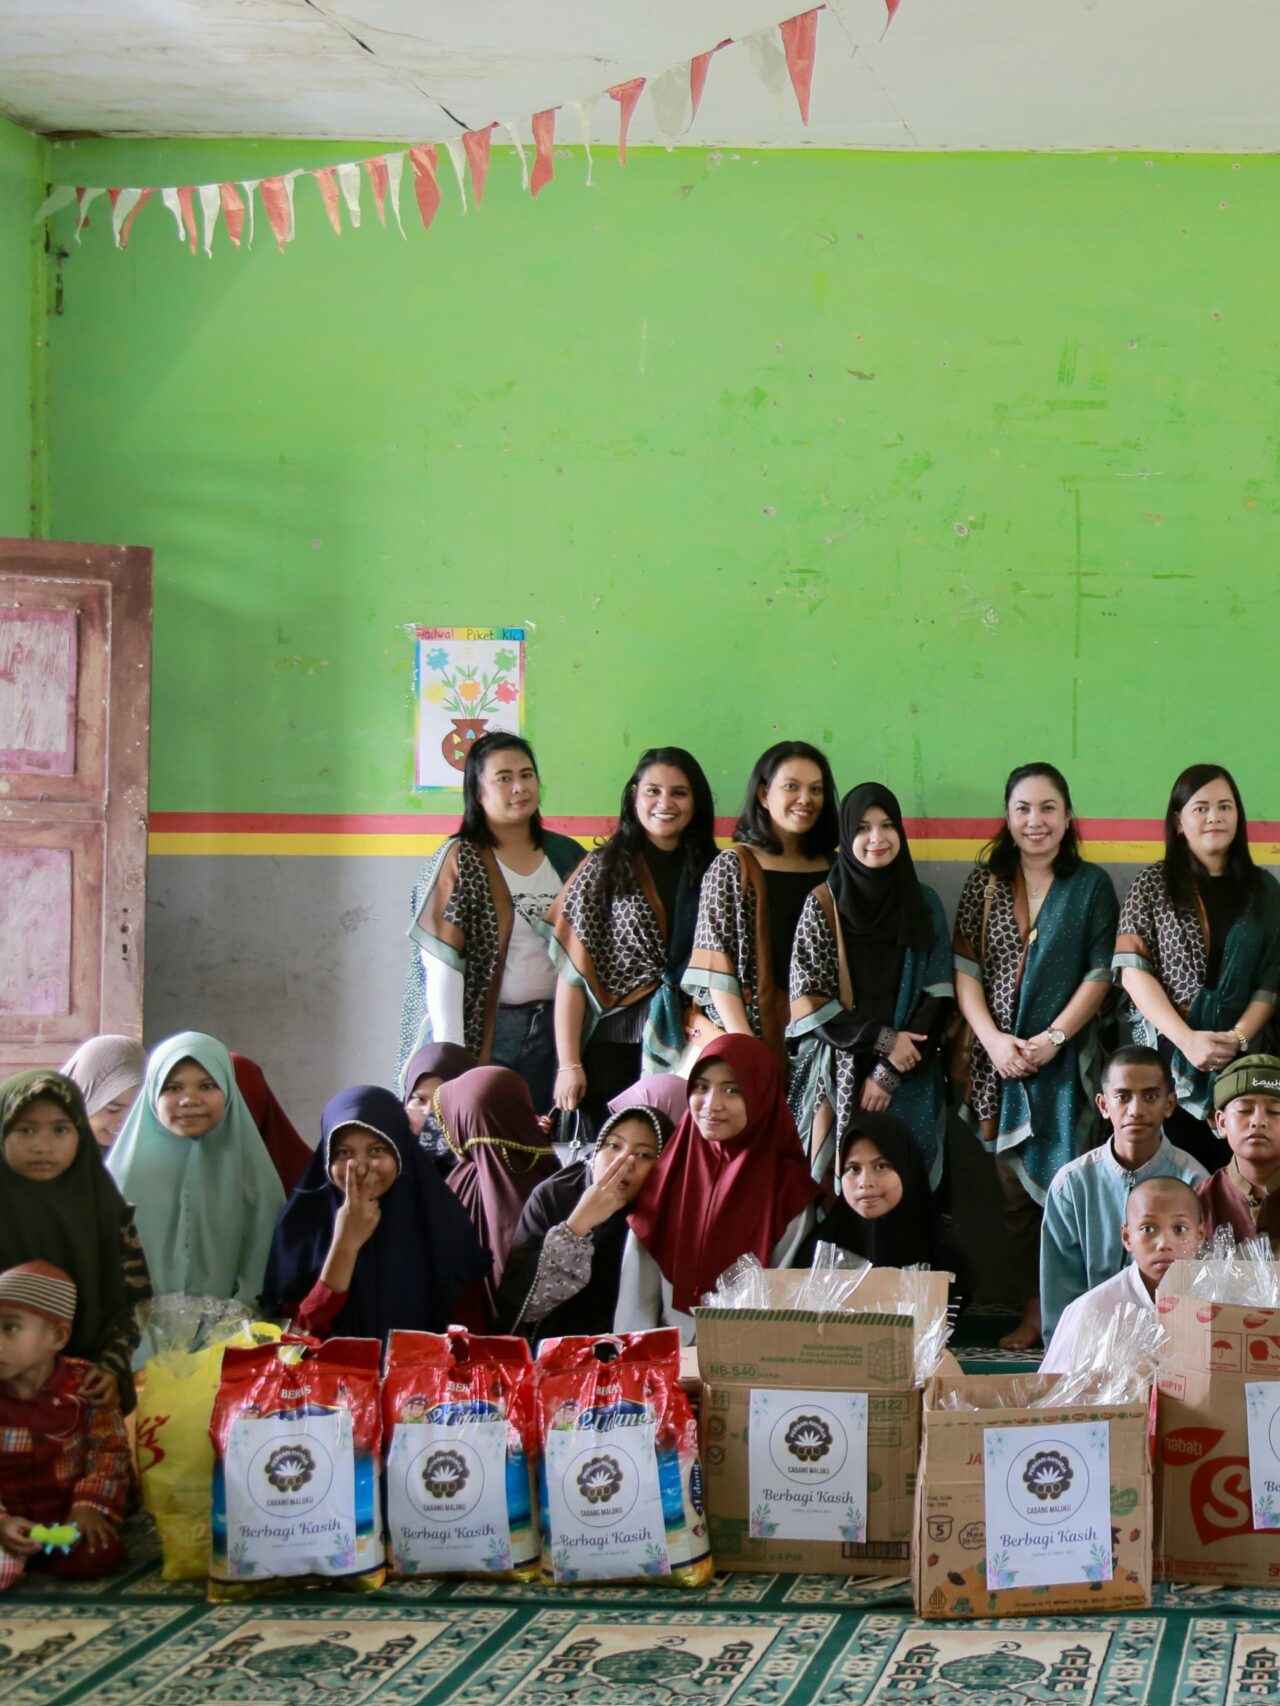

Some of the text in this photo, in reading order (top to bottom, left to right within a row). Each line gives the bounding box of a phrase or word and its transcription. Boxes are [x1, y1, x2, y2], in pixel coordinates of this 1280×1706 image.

[466, 628, 495, 641] Piket
[709, 1364, 756, 1377] NB-S40
[1163, 1436, 1202, 1456] nabati
[966, 1453, 985, 1466] JA
[788, 1466, 830, 1475] CABANG MALUKU
[762, 1488, 854, 1507] Berbagi Kasih
[1027, 1504, 1072, 1515] CABANG MALUKU
[239, 1519, 344, 1541] Berbagi Kasih
[401, 1524, 497, 1543] Berbagi Kasih
[935, 1524, 944, 1536] 5
[559, 1528, 652, 1550] Berbagi Kasih
[1000, 1527, 1098, 1550] Berbagi Kasih
